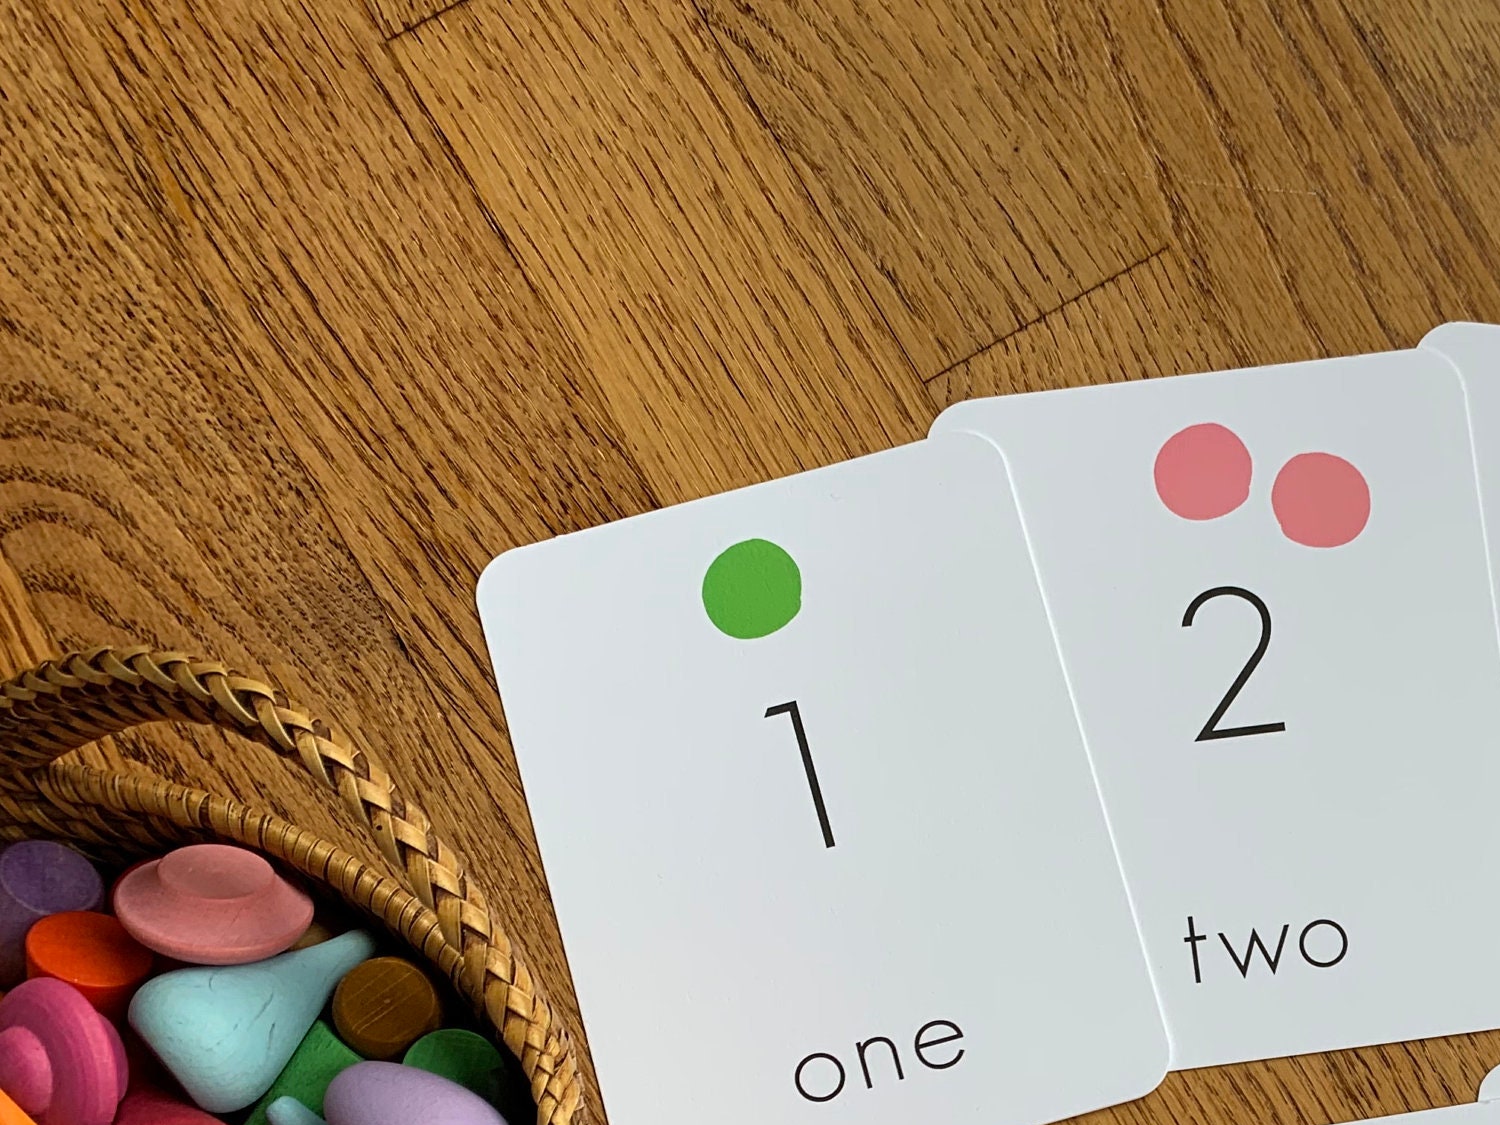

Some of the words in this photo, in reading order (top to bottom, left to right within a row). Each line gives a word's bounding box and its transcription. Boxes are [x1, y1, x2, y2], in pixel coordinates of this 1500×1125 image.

[1180, 584, 1287, 744] 2
[763, 699, 837, 850] 1
[1182, 914, 1350, 985] two
[793, 1018, 966, 1104] one
